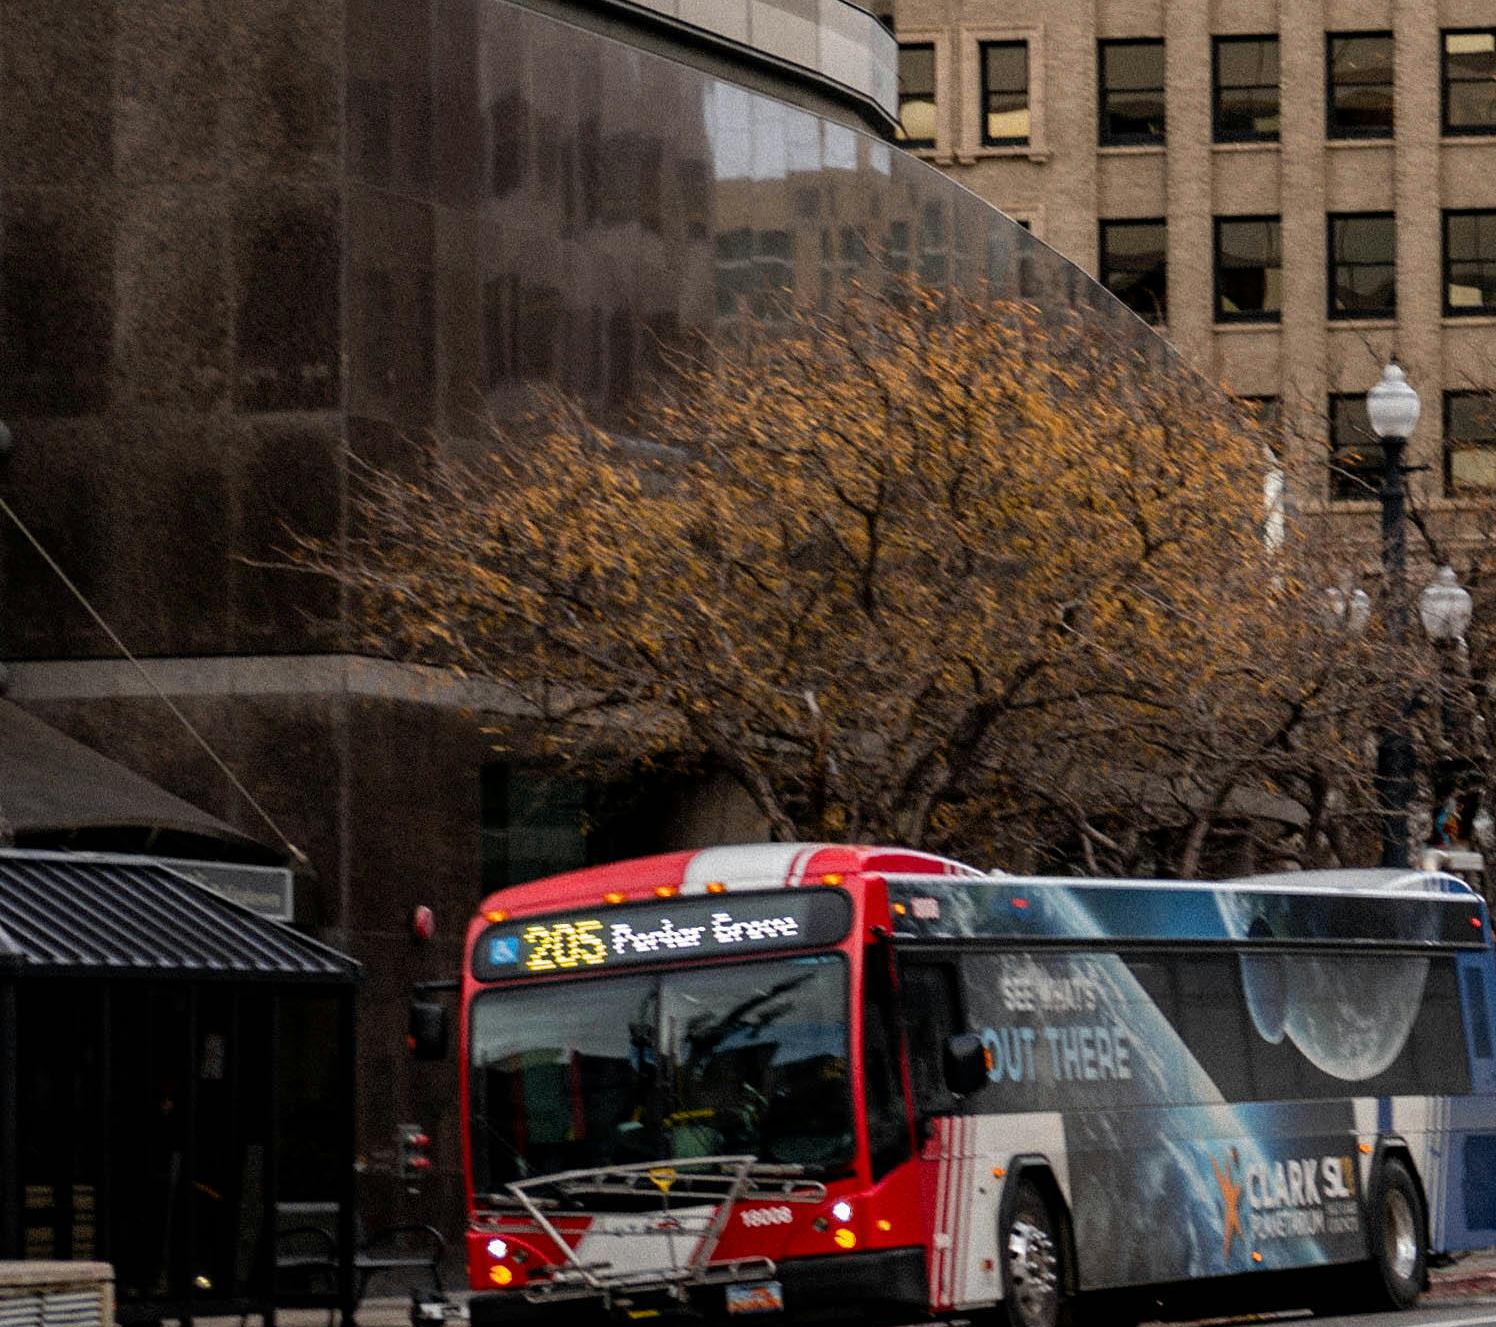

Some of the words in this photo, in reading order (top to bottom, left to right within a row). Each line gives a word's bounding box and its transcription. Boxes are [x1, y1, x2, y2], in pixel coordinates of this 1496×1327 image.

[524, 920, 608, 970] 205
[981, 1026, 1036, 1083] OUT
[1044, 1026, 1135, 1081] THERE
[1247, 1158, 1321, 1211] CLARK
